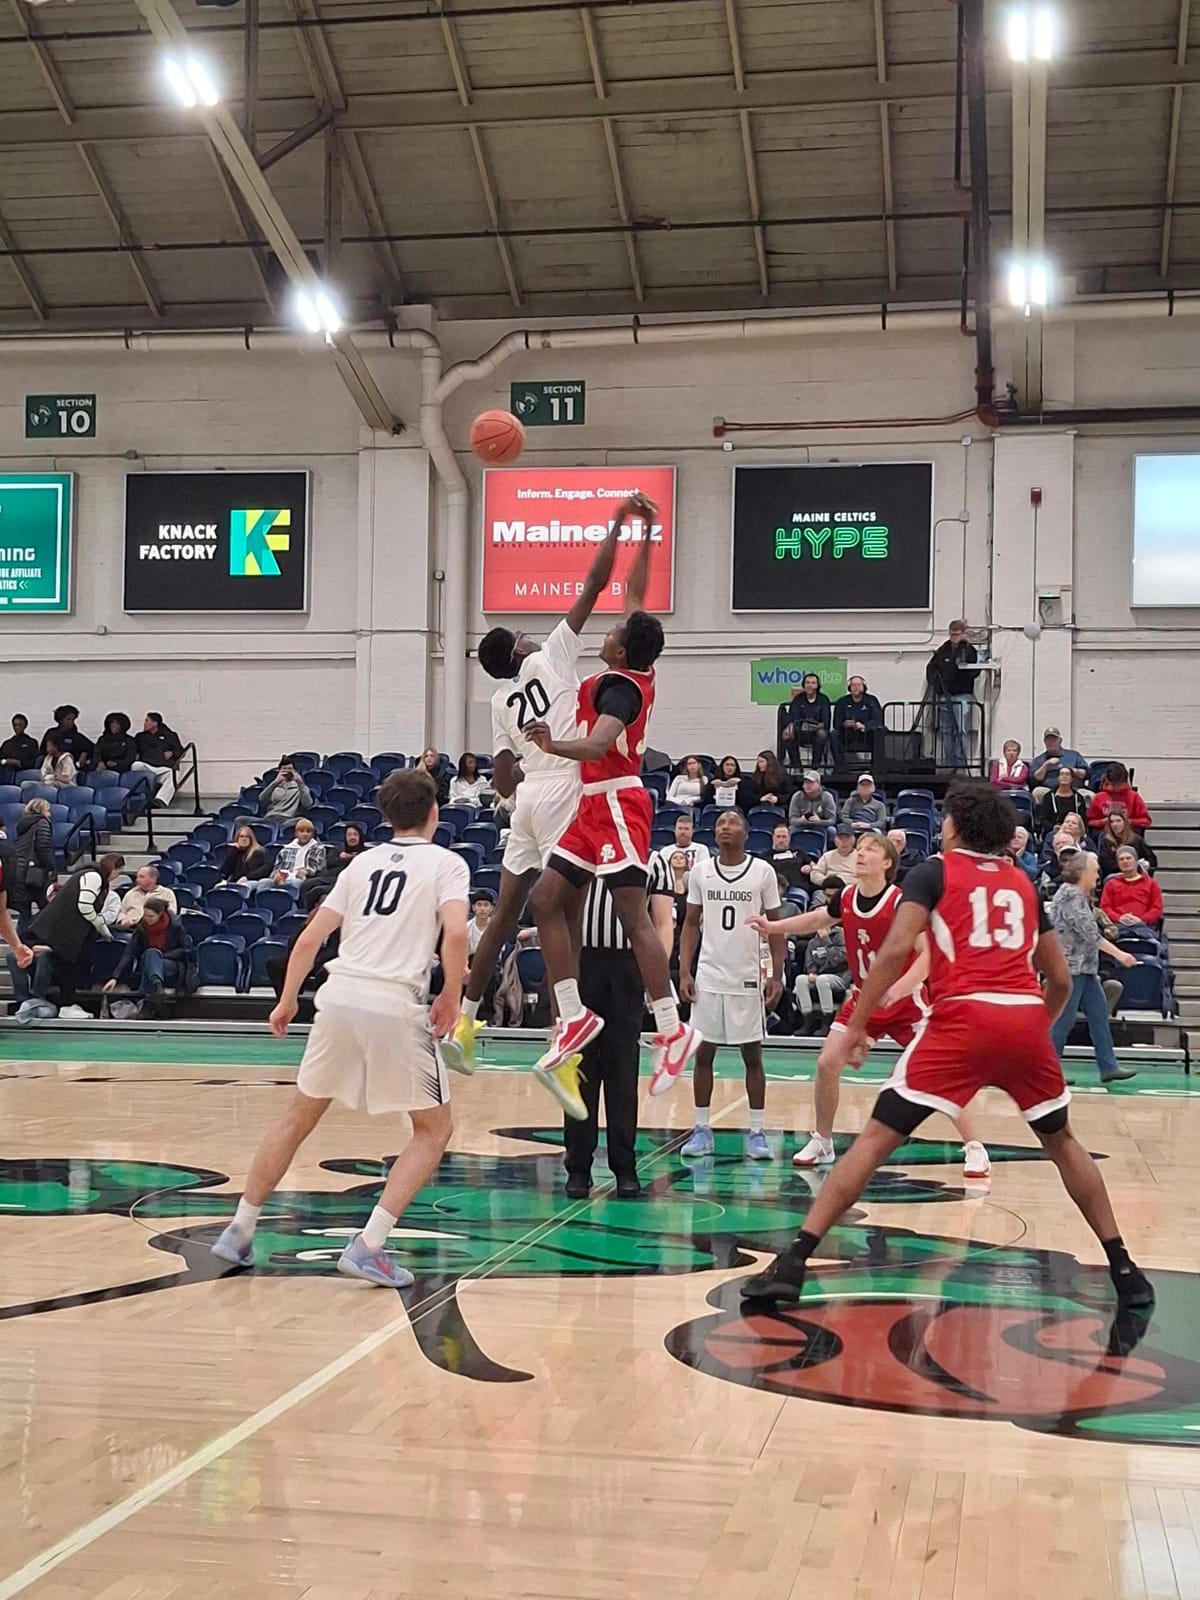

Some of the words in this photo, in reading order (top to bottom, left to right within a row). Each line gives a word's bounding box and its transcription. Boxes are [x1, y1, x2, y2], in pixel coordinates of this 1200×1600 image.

[543, 385, 582, 395] SECTION
[56, 399, 93, 407] SECTION
[550, 397, 575, 421] 11
[58, 410, 91, 434] 10
[517, 489, 553, 499] Inform.
[554, 488, 595, 501] Engage.
[792, 512, 830, 523] MAINE
[833, 511, 877, 522] CELTICS
[158, 524, 217, 540] KNACK
[139, 544, 217, 560] FACTORY
[774, 526, 889, 560] HYPE
[506, 678, 551, 731] 20
[362, 869, 407, 917] 10
[707, 890, 753, 902] BULLDOGS
[721, 905, 736, 931] 0
[968, 886, 1025, 950] 13
